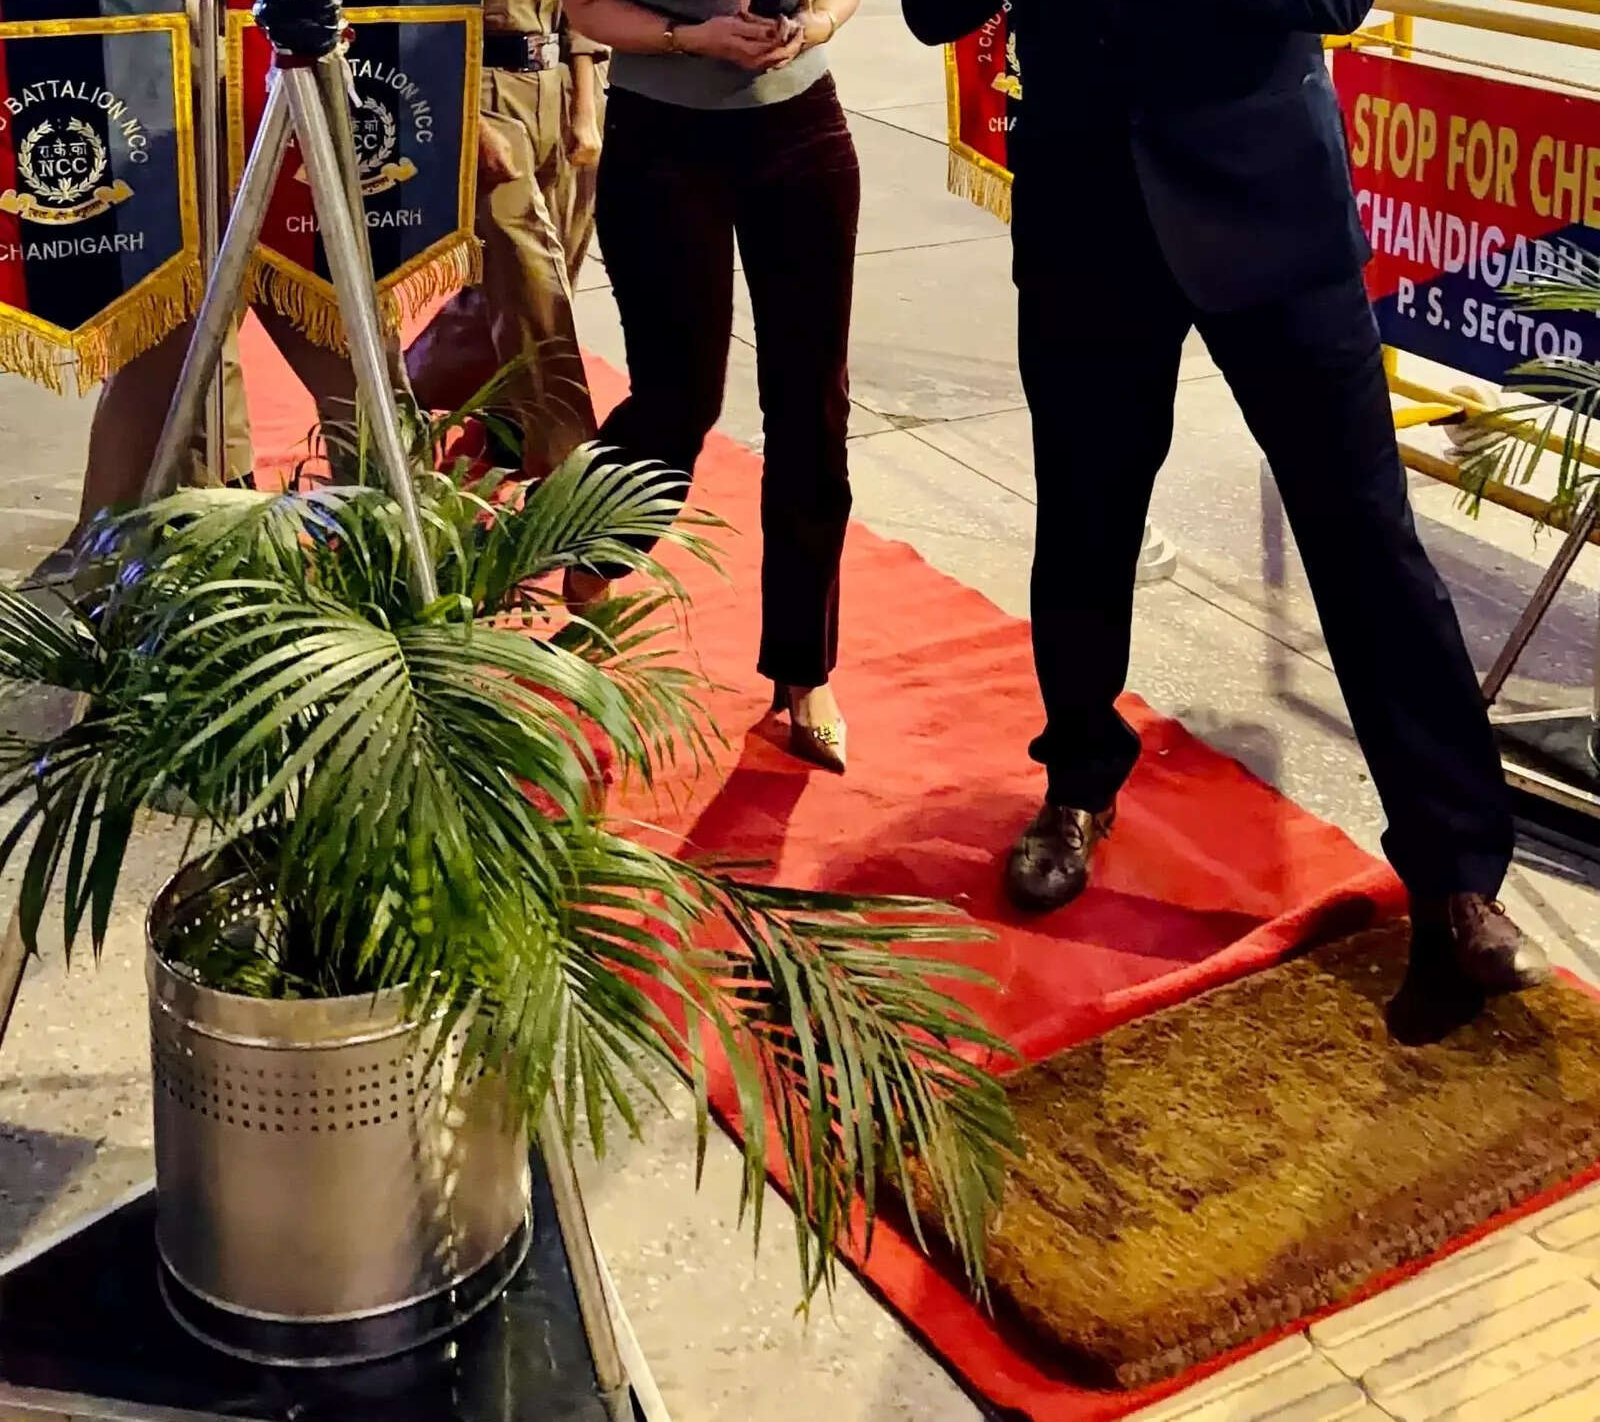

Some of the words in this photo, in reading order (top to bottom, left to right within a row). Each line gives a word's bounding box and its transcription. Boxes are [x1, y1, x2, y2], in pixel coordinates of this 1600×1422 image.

[978, 53, 992, 63] 2
[3, 80, 129, 120] BATTALION
[121, 118, 149, 164] NCC
[411, 100, 433, 143] NCC
[38, 157, 88, 178] NCC
[1353, 94, 1437, 182] STOP
[1447, 115, 1518, 208] FOR
[1530, 135, 1600, 229] CHE
[1397, 277, 1416, 319] P.
[1427, 285, 1450, 330] S.
[1462, 297, 1583, 366] SECTOR
